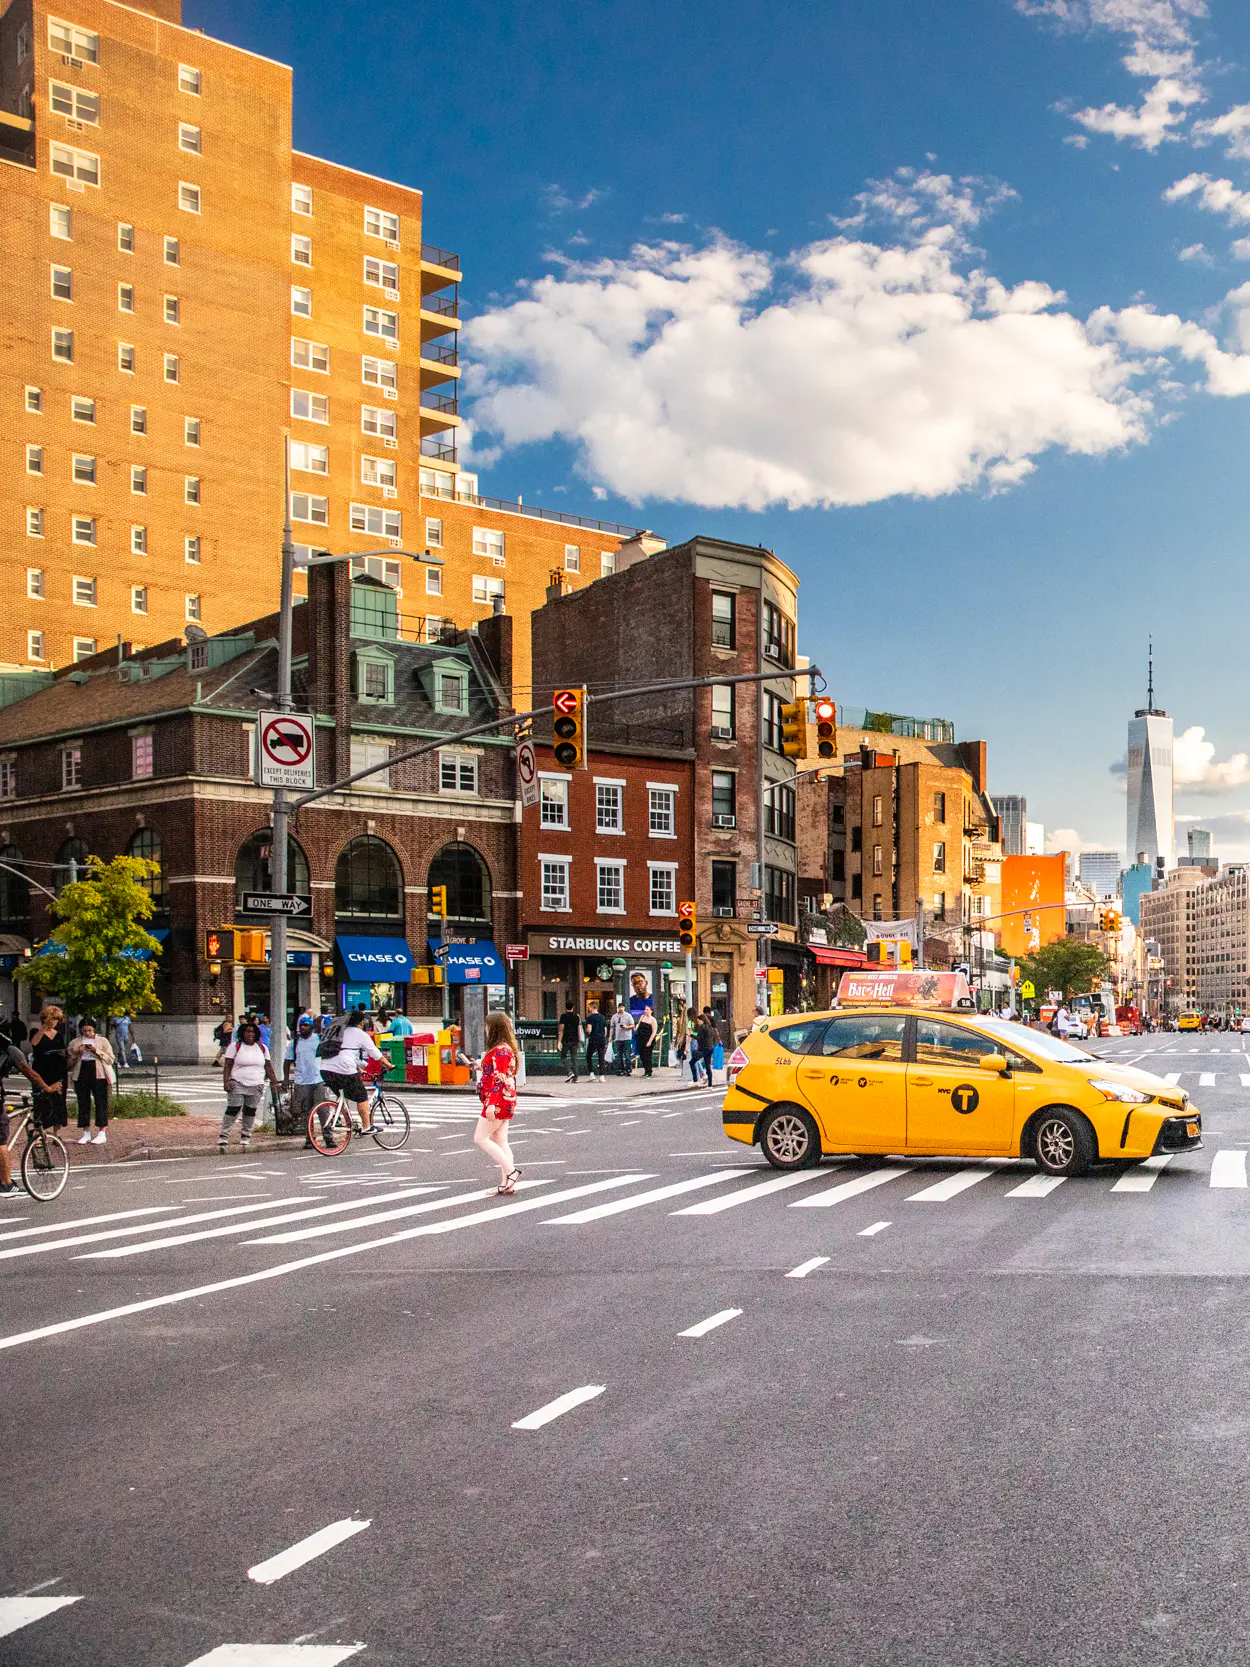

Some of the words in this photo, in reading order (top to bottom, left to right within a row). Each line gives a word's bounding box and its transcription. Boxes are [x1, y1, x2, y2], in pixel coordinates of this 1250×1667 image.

[263, 767, 282, 775] EXCEPT
[284, 769, 312, 777] DELIVERIES
[252, 898, 273, 909] ONE
[281, 900, 302, 910] WAY
[449, 937, 467, 945] GROVE
[469, 937, 477, 945] ST
[549, 936, 630, 951] STARBUCKS
[634, 940, 681, 953] COFFEE
[348, 953, 394, 963] CHASE
[873, 982, 895, 999] Hell
[514, 1026, 541, 1036] ubway
[957, 1088, 974, 1111] T
